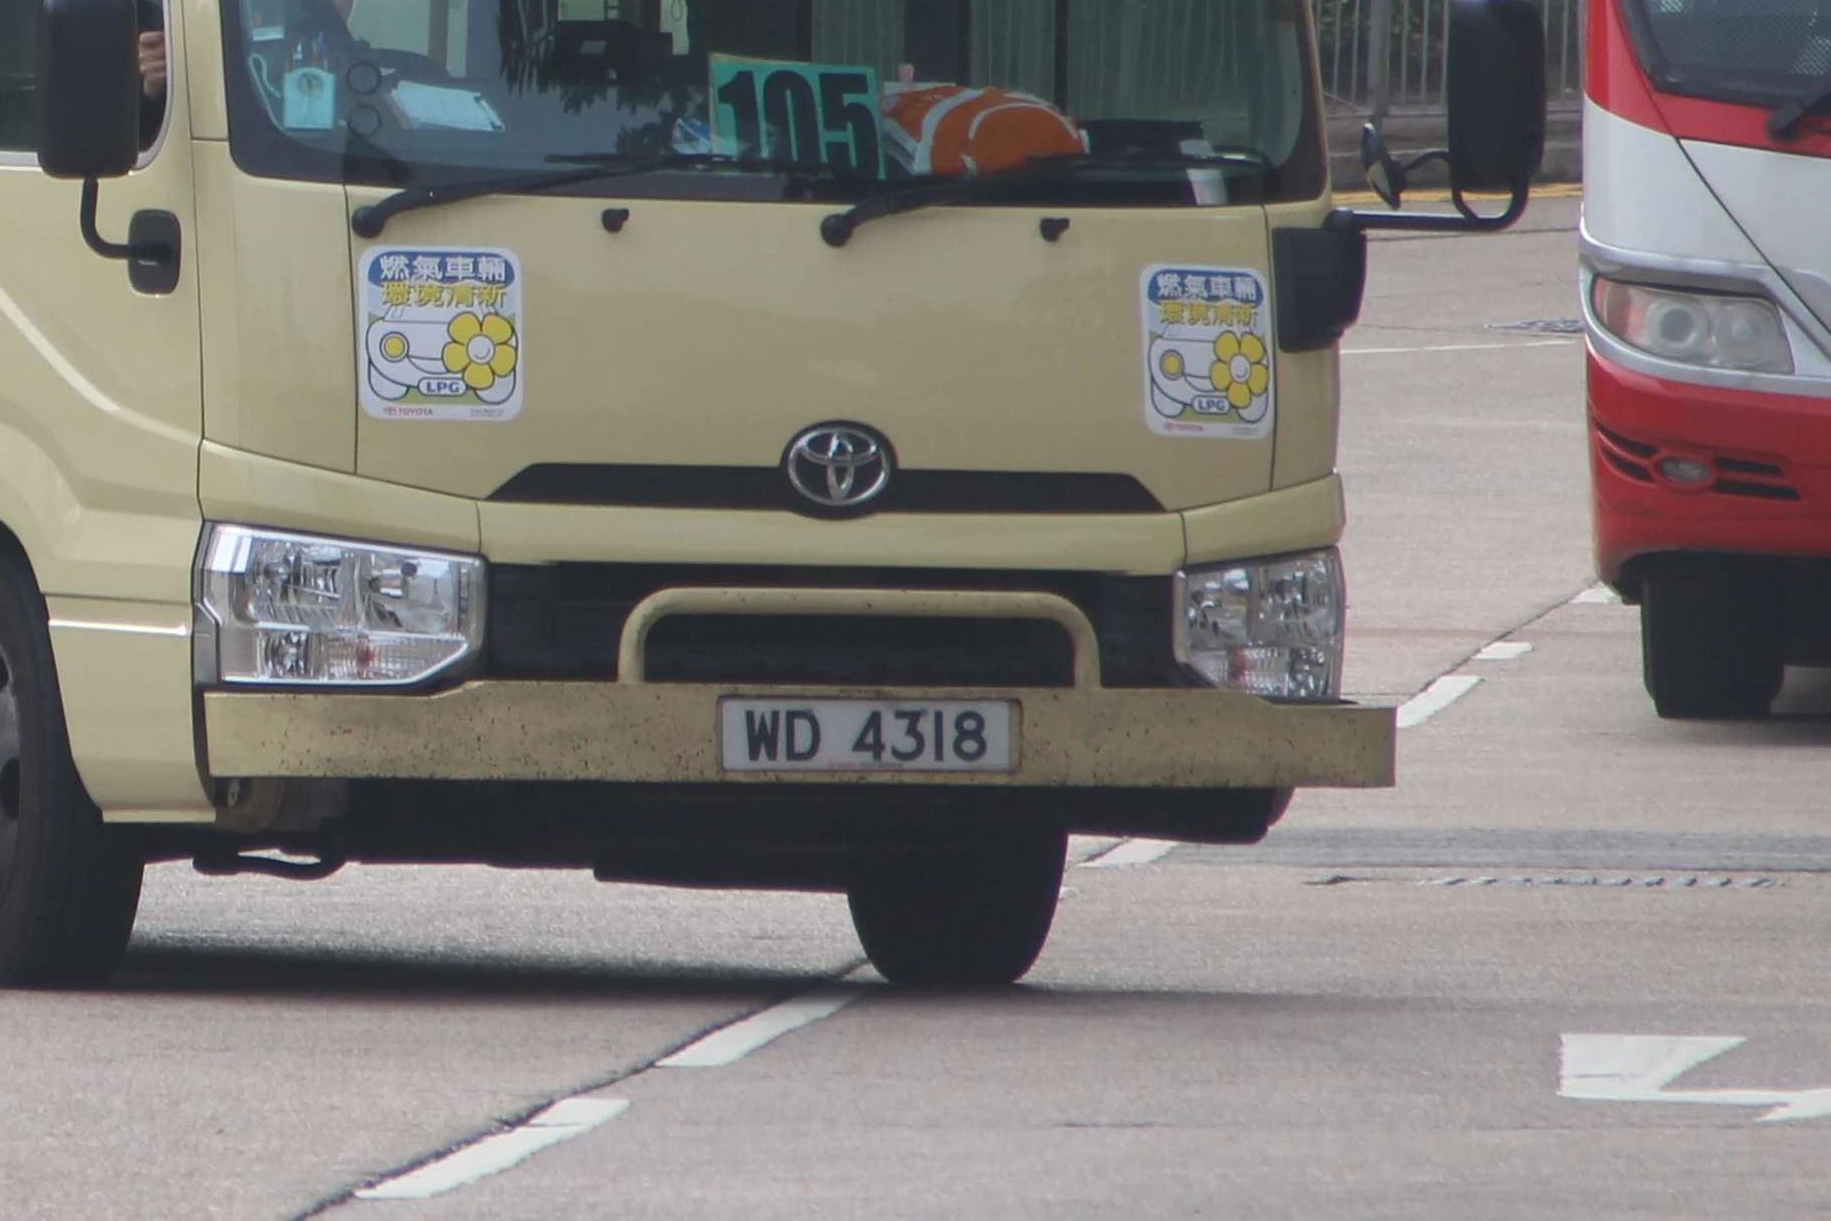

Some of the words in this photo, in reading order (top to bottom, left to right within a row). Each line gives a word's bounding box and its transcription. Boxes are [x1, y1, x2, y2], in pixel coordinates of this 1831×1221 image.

[717, 68, 883, 178] 105
[425, 381, 461, 394] LPG
[1197, 398, 1226, 412] LPG
[744, 709, 821, 762] WD
[851, 709, 988, 763] 4318
